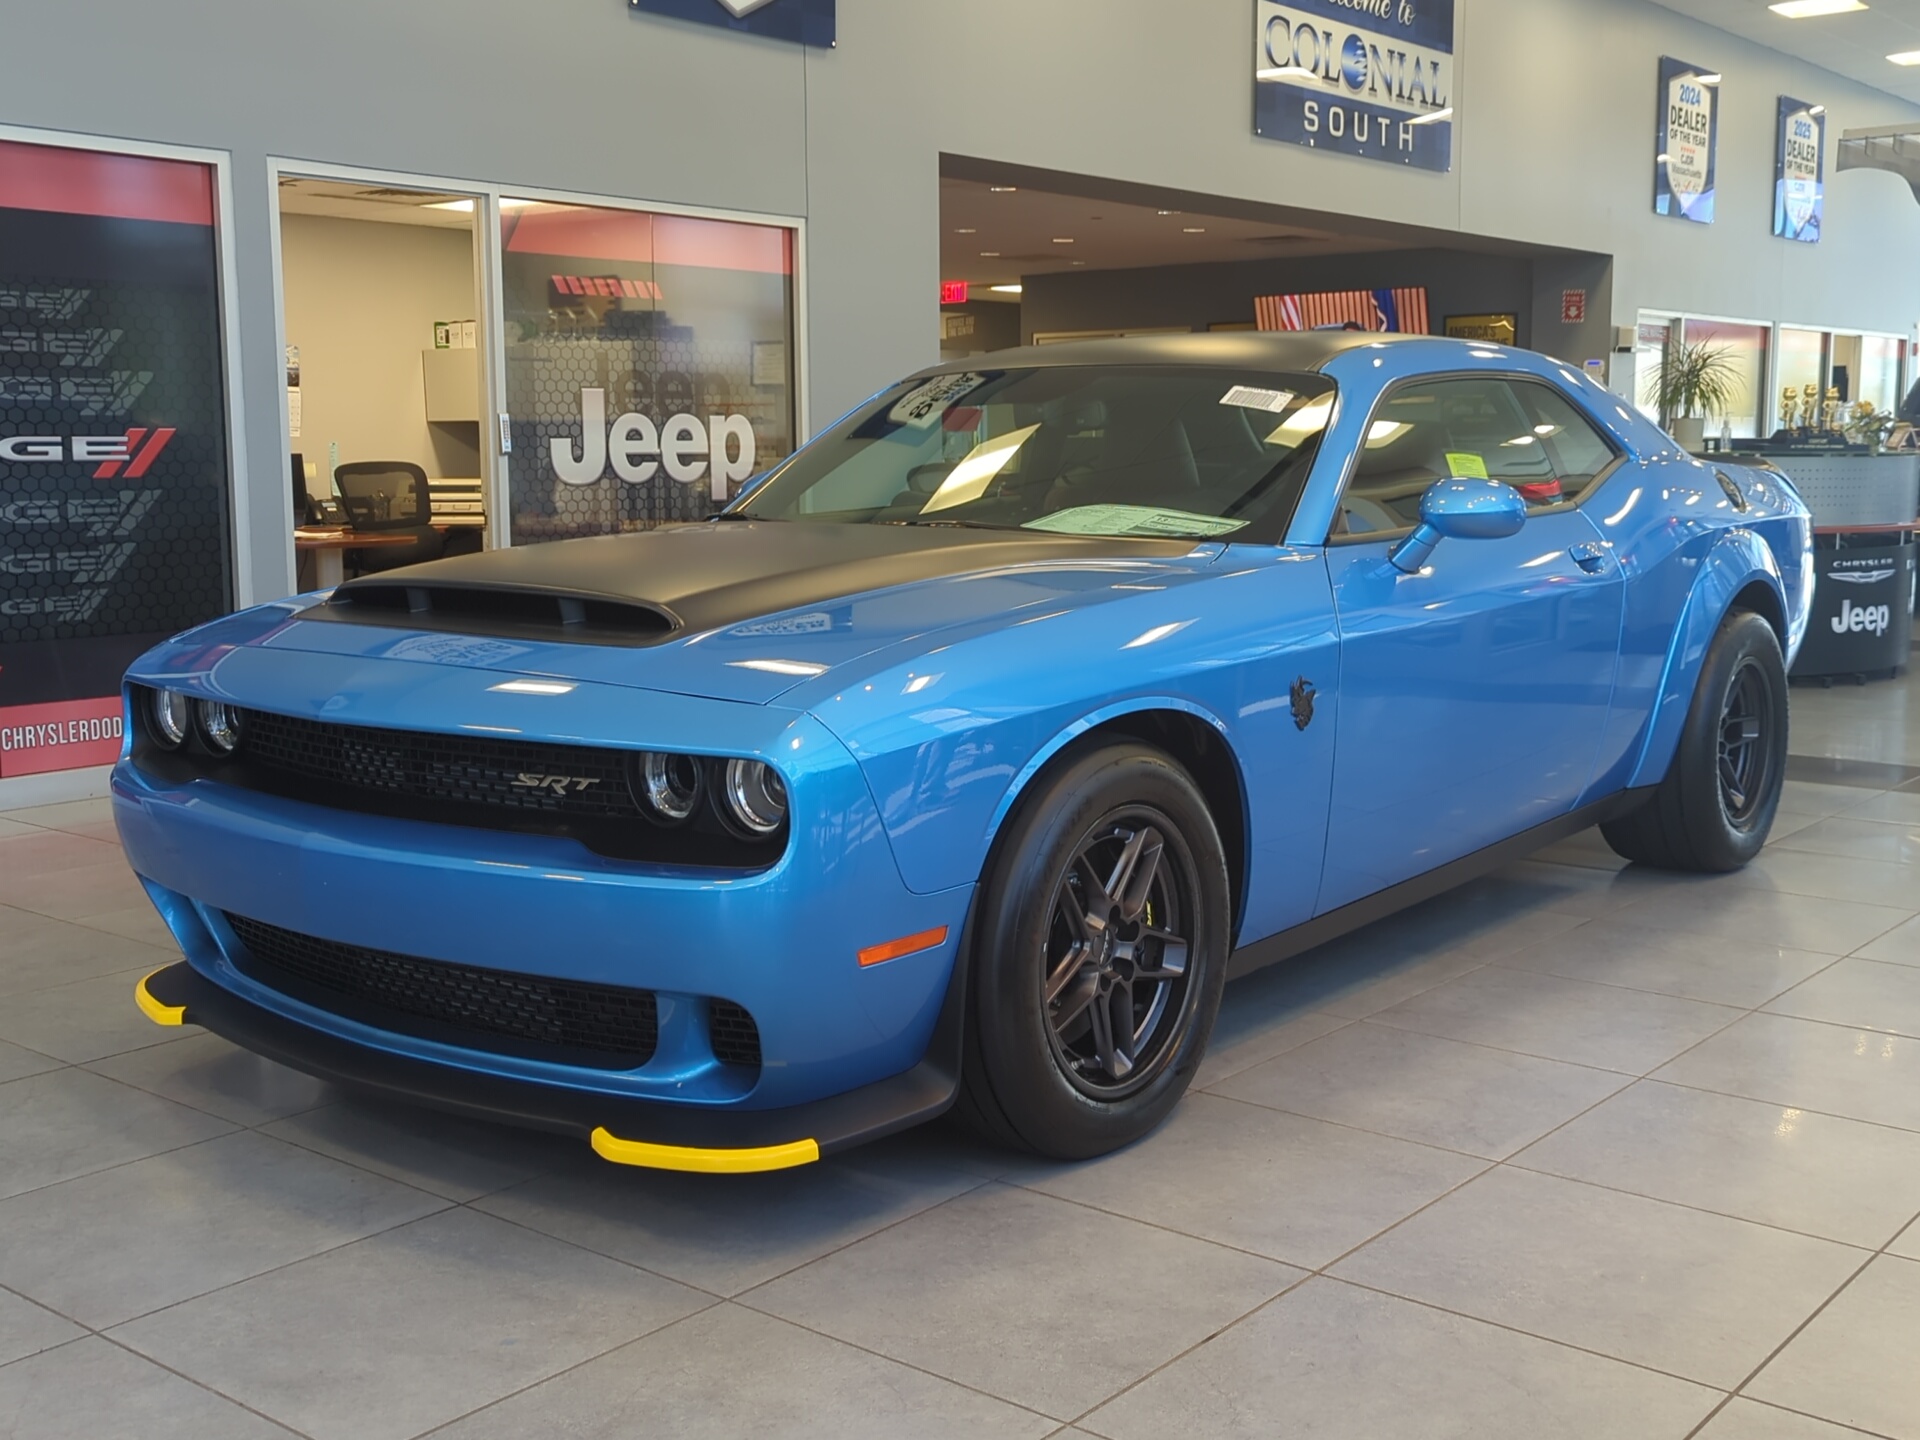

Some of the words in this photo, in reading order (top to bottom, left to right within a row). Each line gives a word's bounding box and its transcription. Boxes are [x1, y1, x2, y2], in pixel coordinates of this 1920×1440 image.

[1327, 0, 1392, 19] come
[1397, 0, 1416, 26] to
[1264, 14, 1447, 109] COLONIAL
[1679, 83, 1702, 107] 2024
[1303, 100, 1413, 152] SOUTH
[1670, 104, 1708, 135] DEALER
[1794, 119, 1812, 140] 2025
[1670, 127, 1679, 140] OF
[1680, 130, 1691, 144] THE
[1692, 133, 1707, 148] YEAR
[1786, 138, 1816, 163] DEALER
[549, 387, 756, 501] Jeep
[1832, 558, 1894, 569] CHRYSLER
[1831, 599, 1890, 637] Jeep
[510, 772, 601, 795] SRT
